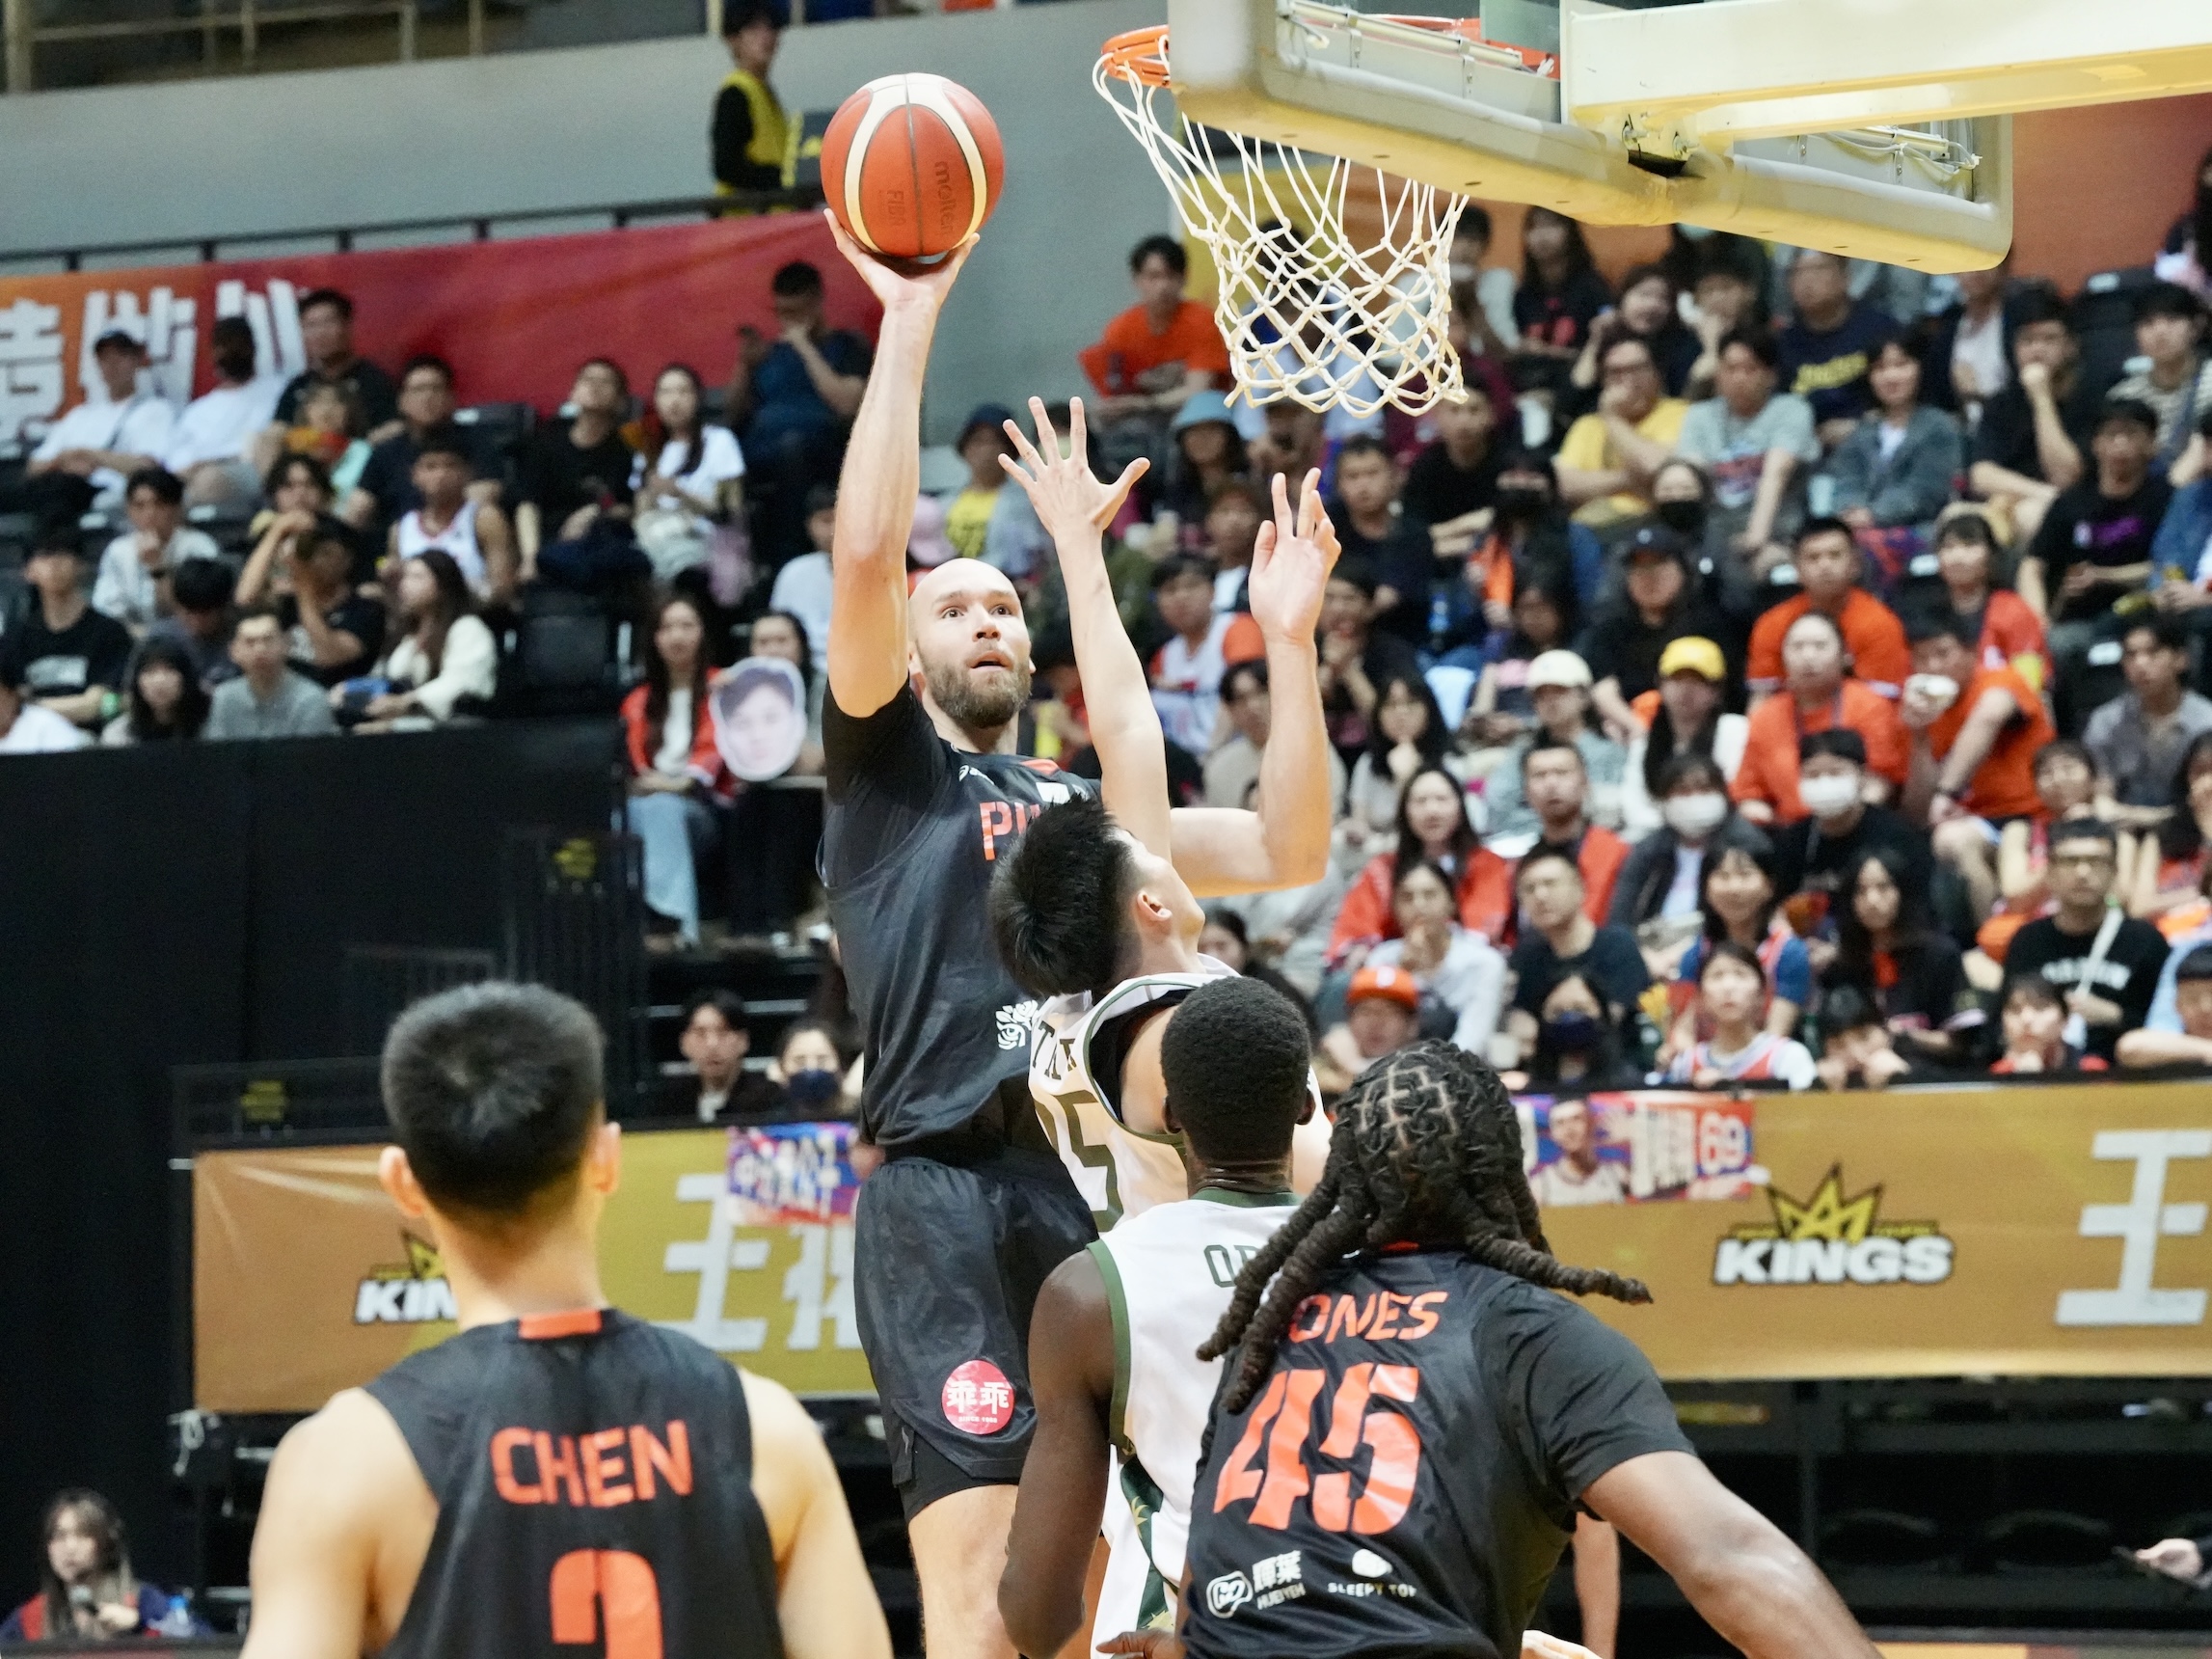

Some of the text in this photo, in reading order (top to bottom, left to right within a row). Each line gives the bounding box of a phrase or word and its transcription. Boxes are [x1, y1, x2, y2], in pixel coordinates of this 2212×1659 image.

[1713, 1236, 1954, 1284] KINGS
[354, 1279, 458, 1322] KIN
[1288, 1291, 1448, 1344] ONES
[946, 1380, 1010, 1415] 乖乖
[490, 1419, 693, 1508] CHEN
[1213, 1362, 1420, 1536] 45
[1328, 1582, 1383, 1597] SLEEPY
